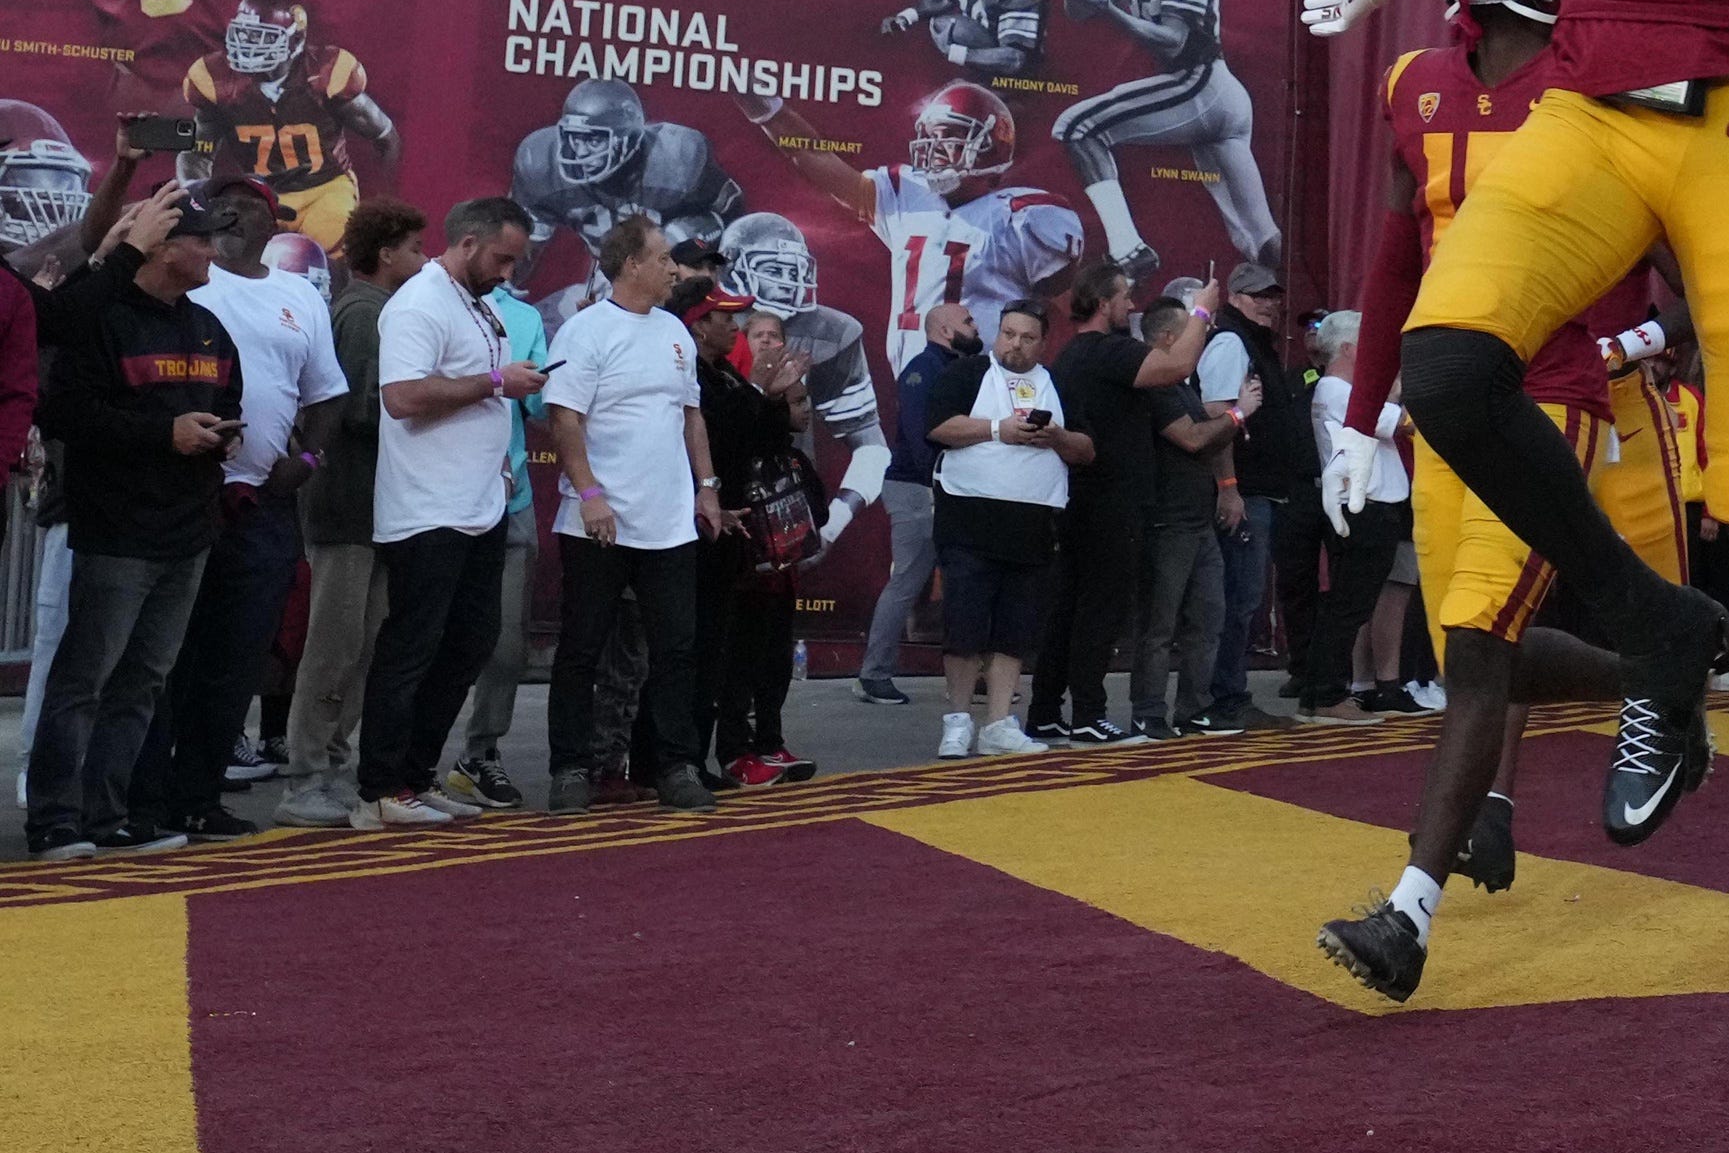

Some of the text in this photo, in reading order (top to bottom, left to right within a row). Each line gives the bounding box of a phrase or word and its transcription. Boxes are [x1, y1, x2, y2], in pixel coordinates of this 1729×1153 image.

[14, 40, 135, 62] SMITH-SCHUSTER
[503, 35, 883, 107] CHAMPIONSHIPS
[991, 76, 1079, 96] ANTHONY DAVIS
[235, 123, 324, 176] 70
[779, 136, 863, 154] MATT LEINART
[1151, 167, 1220, 183] LYNN SWANN
[897, 234, 972, 332] 11
[806, 599, 836, 612] LOTT
